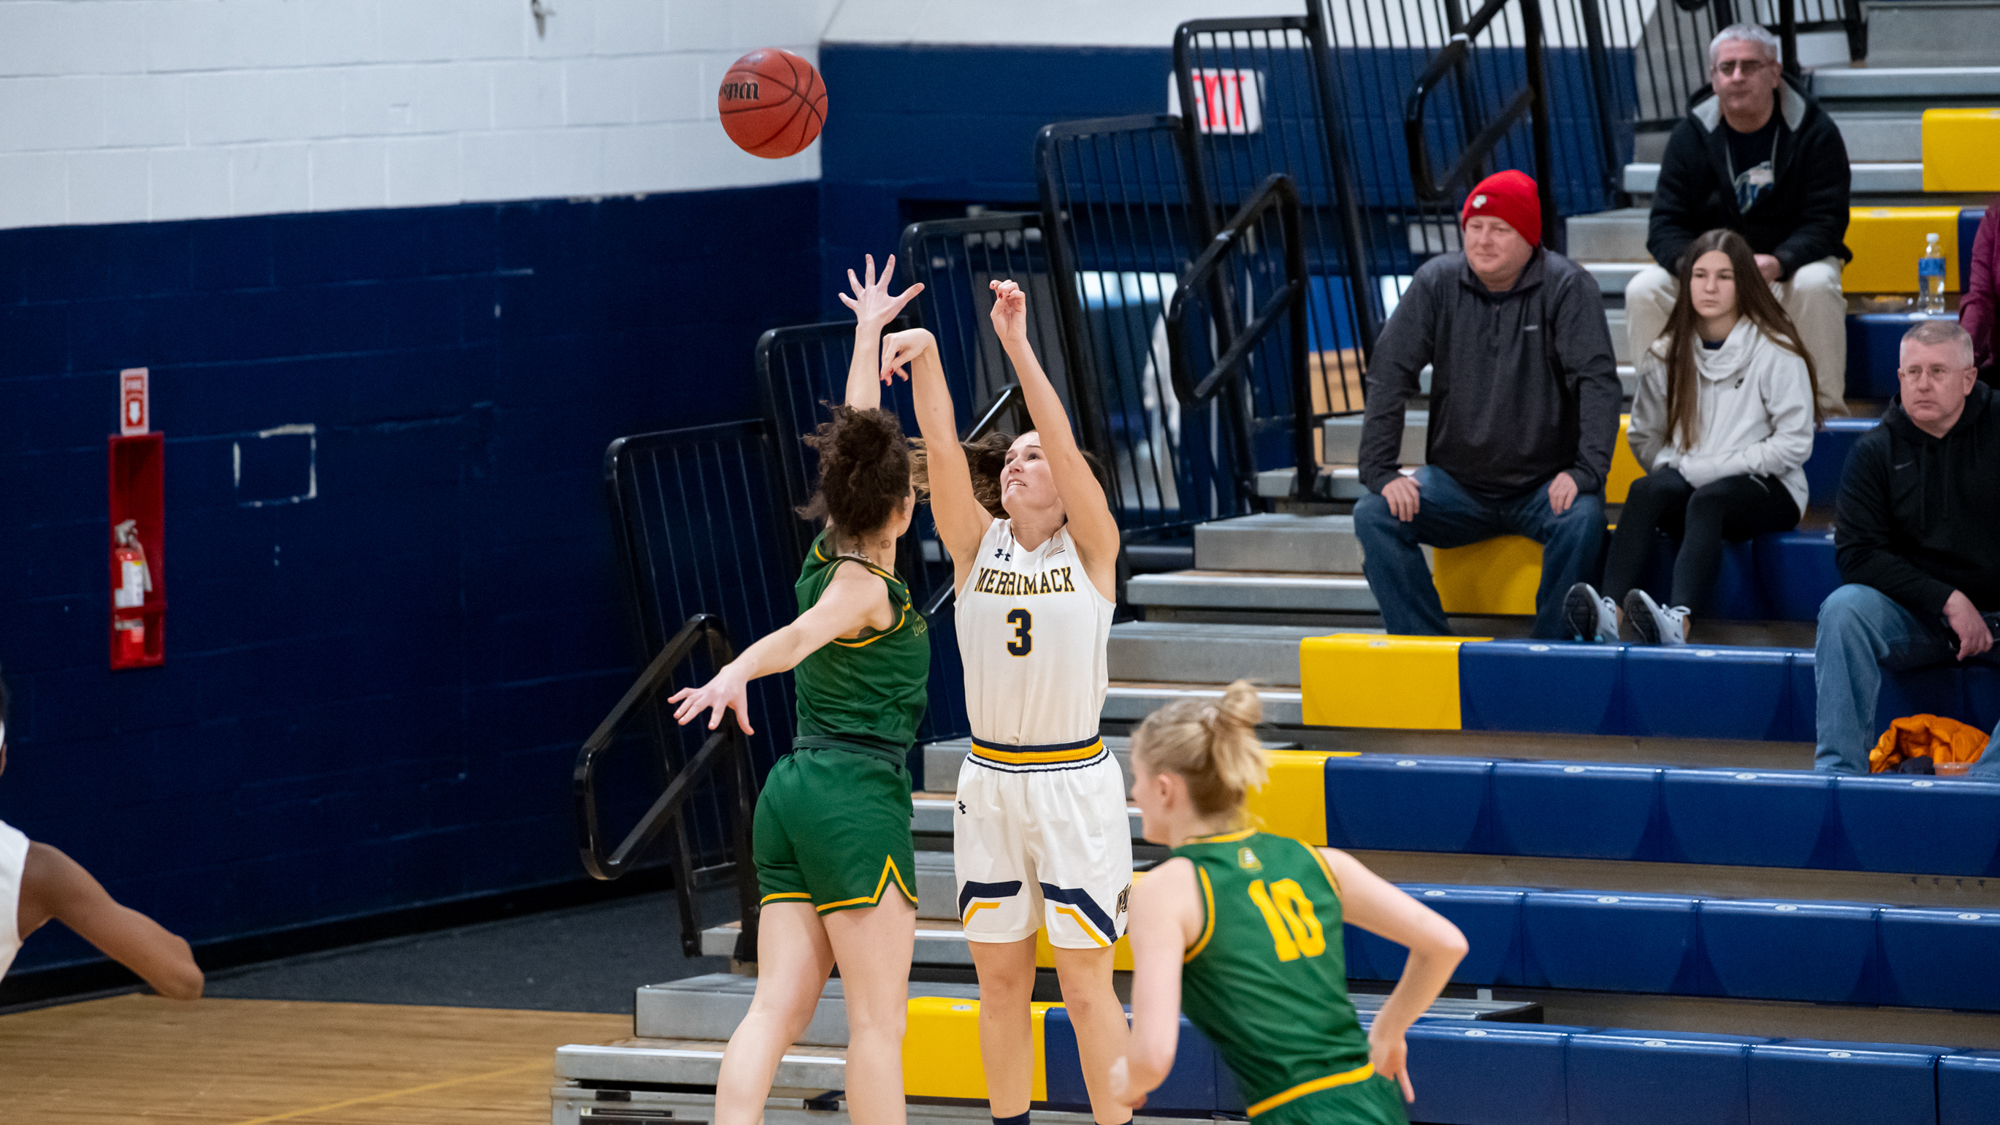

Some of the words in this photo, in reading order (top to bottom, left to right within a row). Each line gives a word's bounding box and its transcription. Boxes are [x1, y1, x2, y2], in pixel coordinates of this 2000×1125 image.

[719, 82, 759, 101] Wilso
[974, 566, 1075, 596] MERRIMACK
[1006, 608, 1033, 657] 3
[1248, 878, 1326, 962] 10
